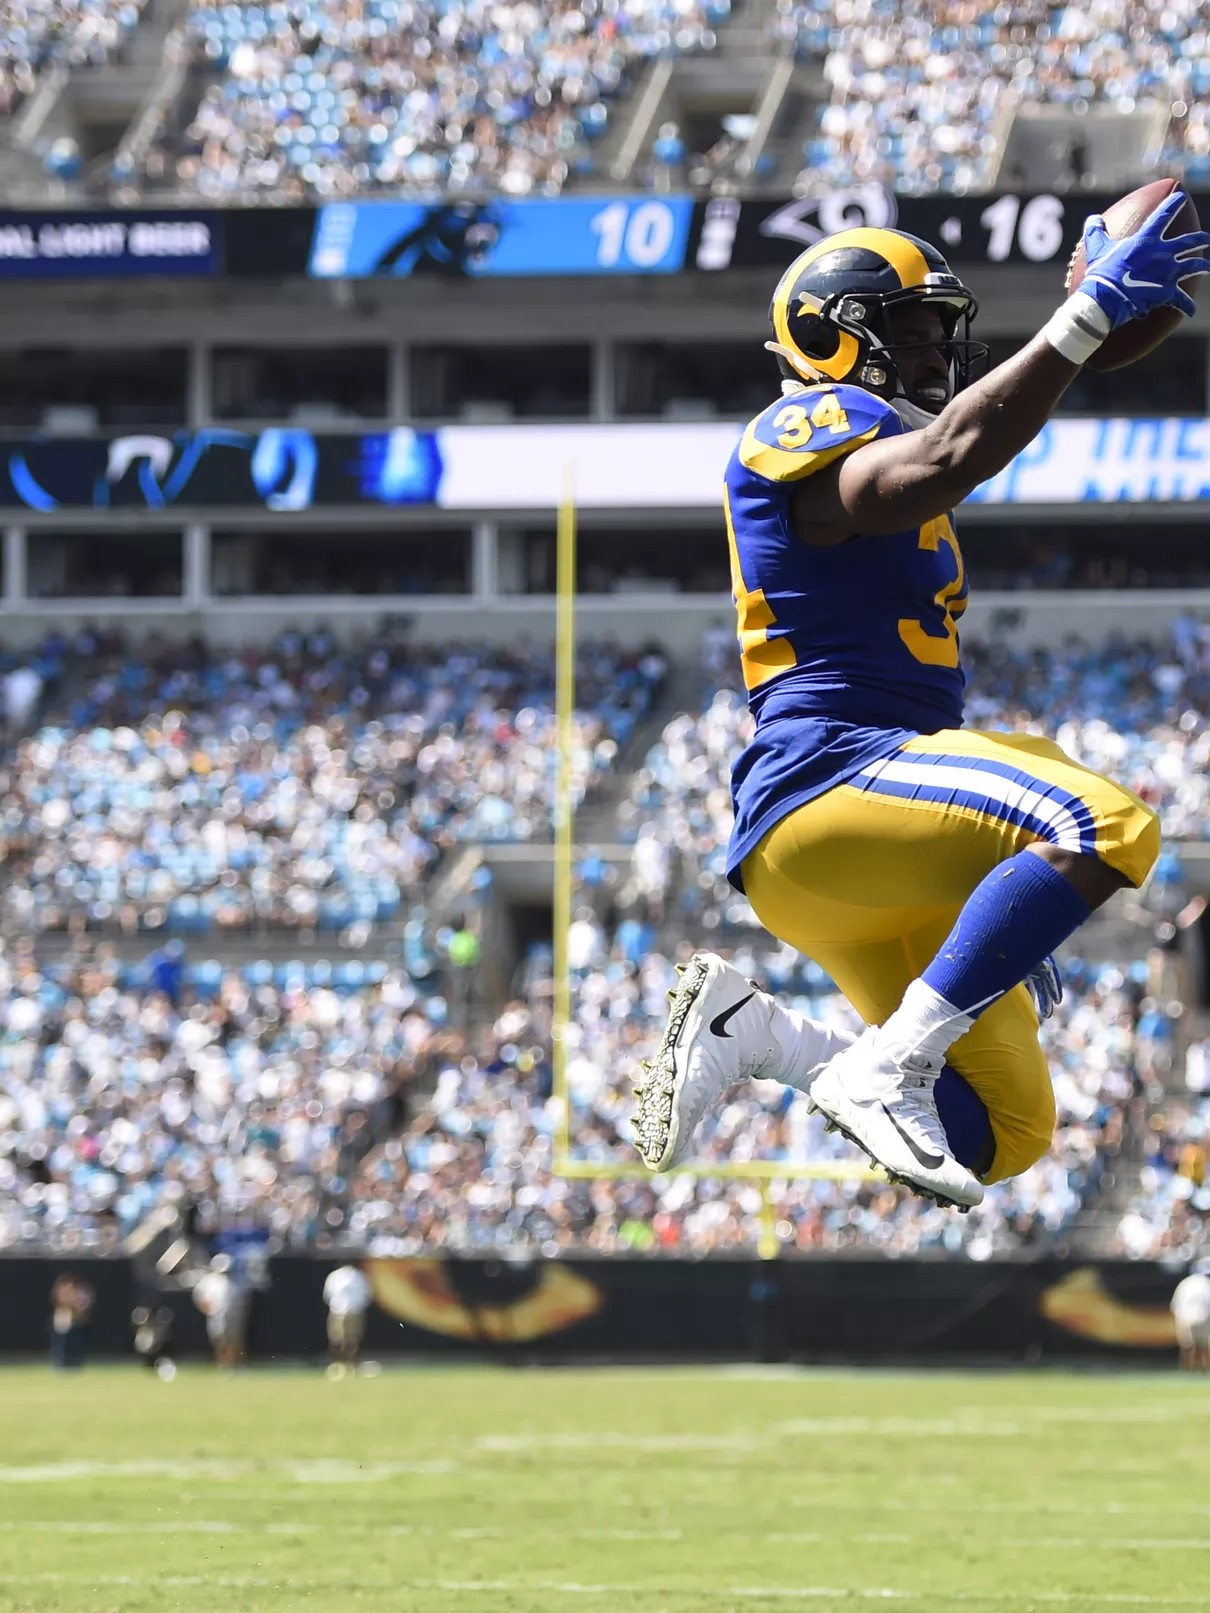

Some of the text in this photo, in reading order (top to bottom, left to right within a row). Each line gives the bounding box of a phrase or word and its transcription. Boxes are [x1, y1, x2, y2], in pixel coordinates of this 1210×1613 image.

[589, 202, 674, 268] 10
[980, 195, 1064, 263] 16
[772, 392, 851, 449] 34
